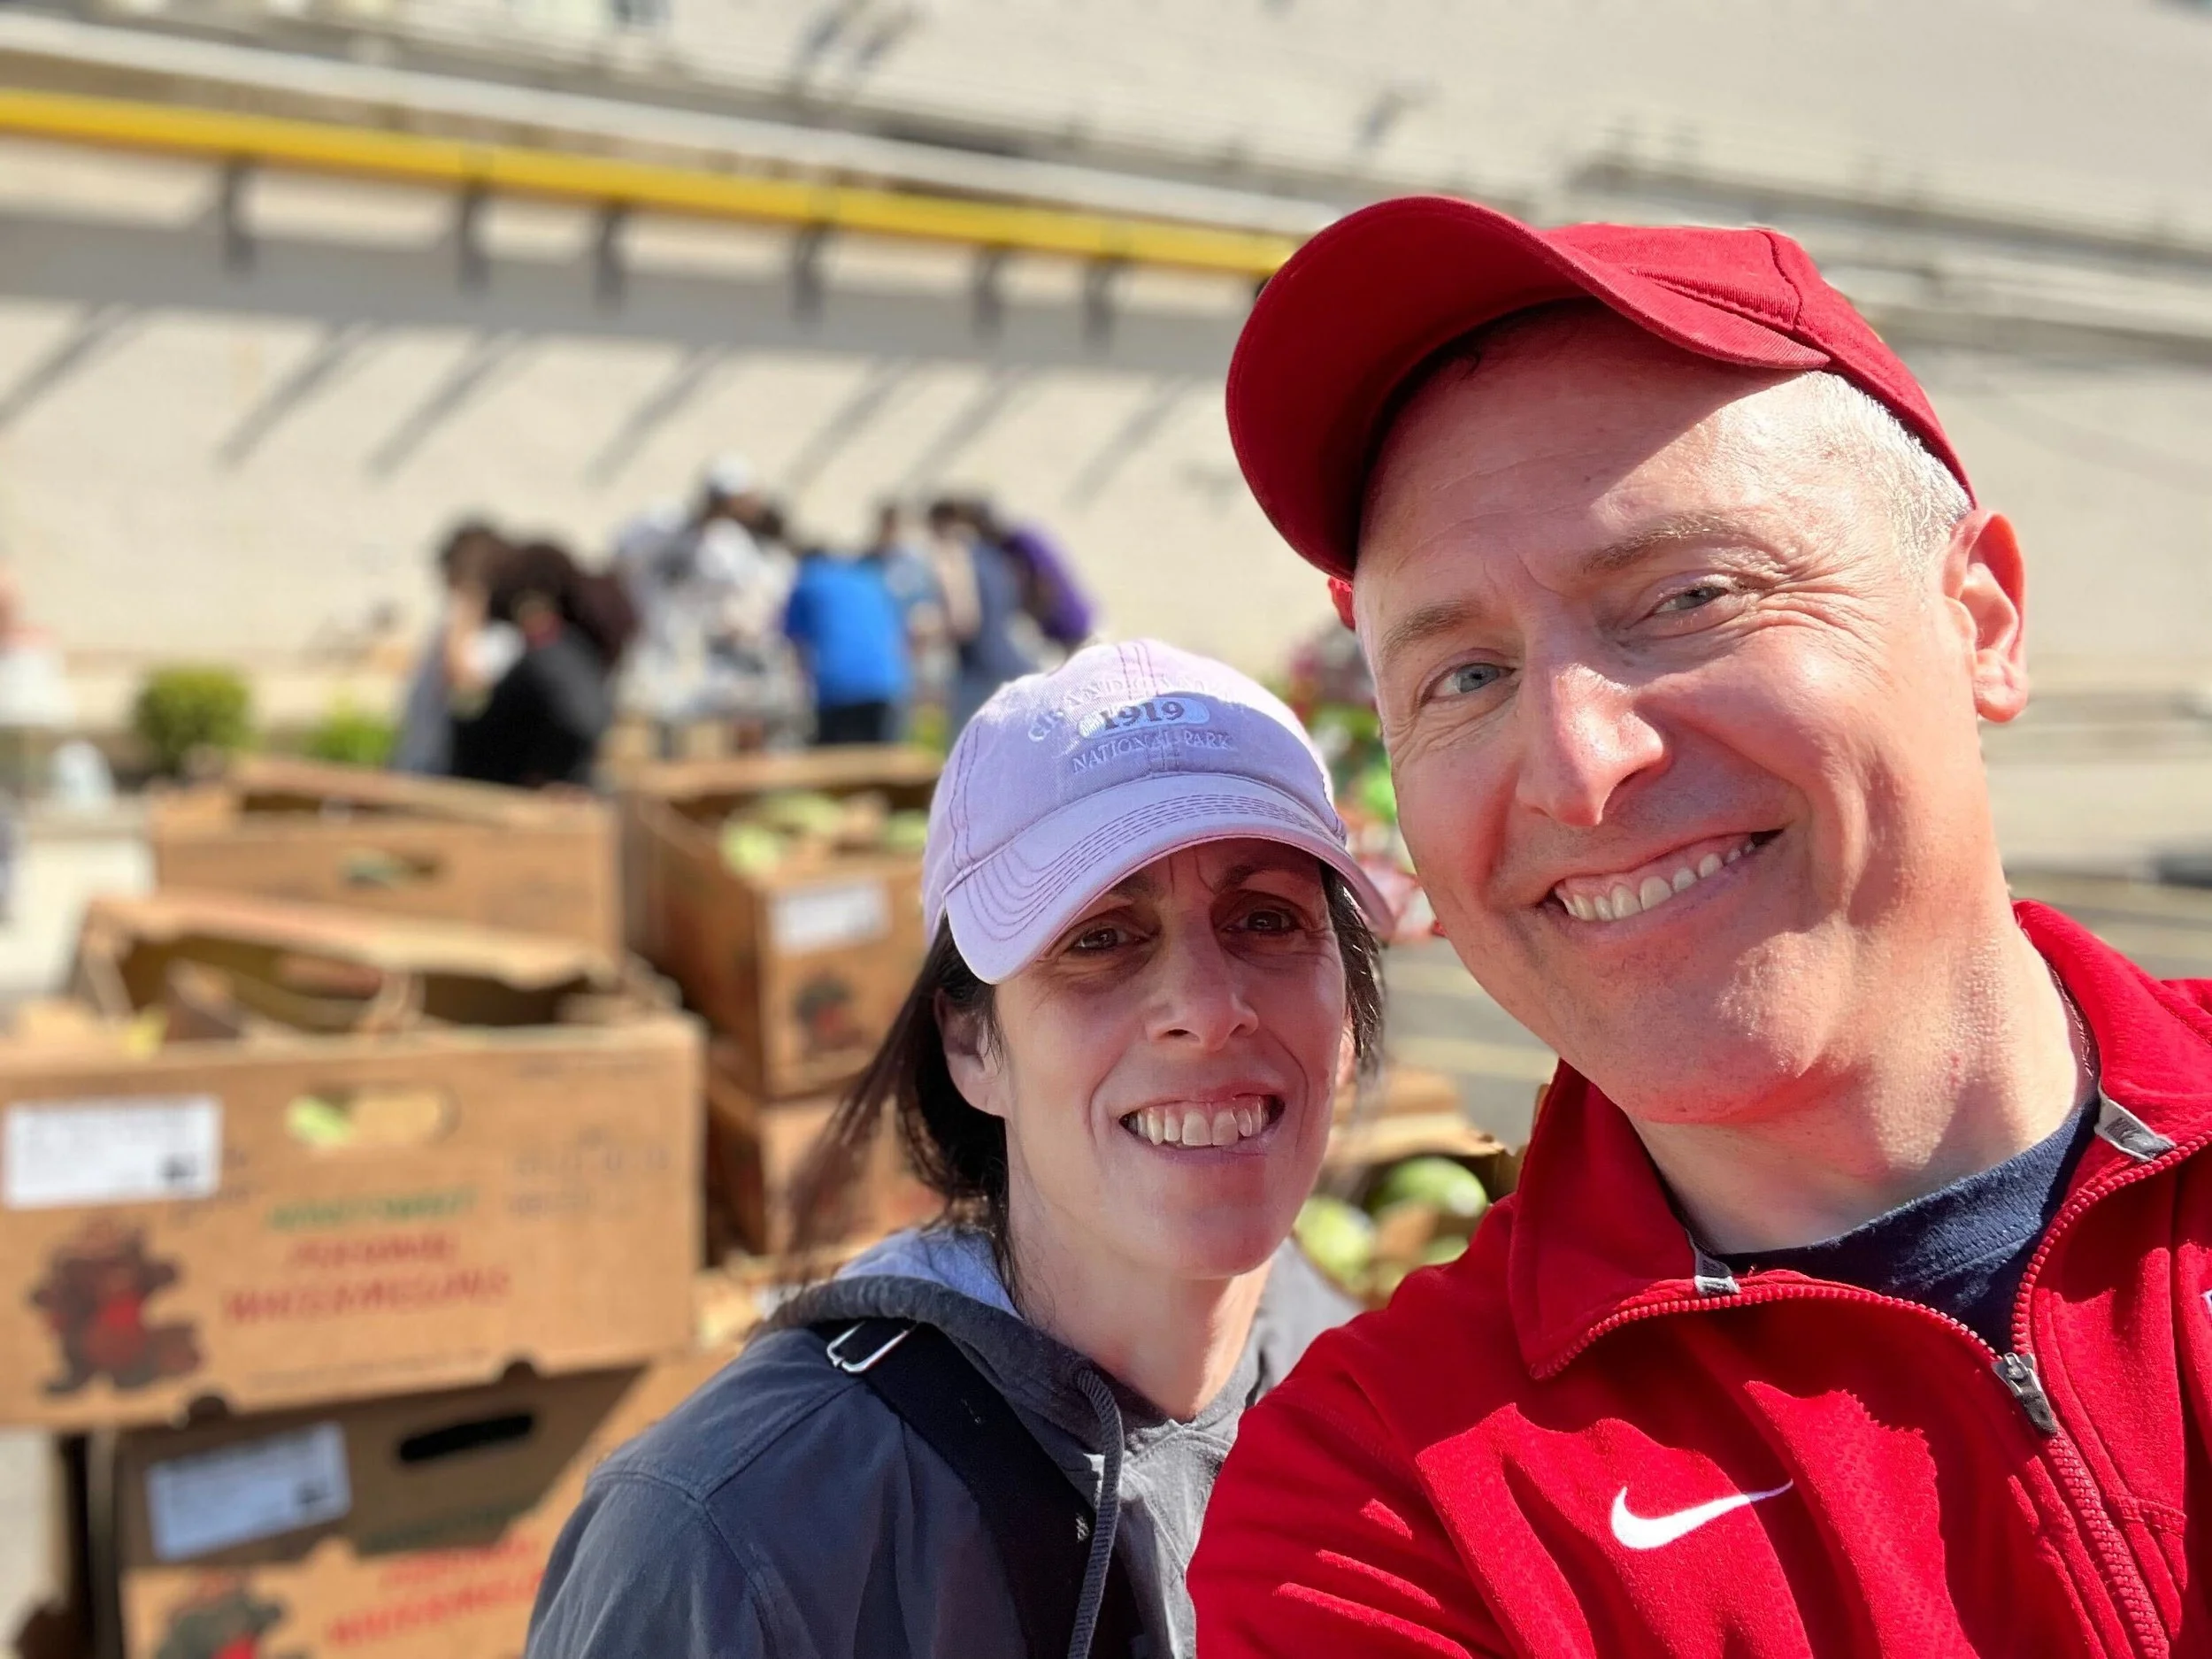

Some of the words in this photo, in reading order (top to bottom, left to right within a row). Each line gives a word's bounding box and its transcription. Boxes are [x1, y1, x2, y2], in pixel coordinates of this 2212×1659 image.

[1099, 701, 1186, 731] 1919
[1071, 731, 1175, 774] NATIONAL
[1183, 730, 1235, 750] PARK
